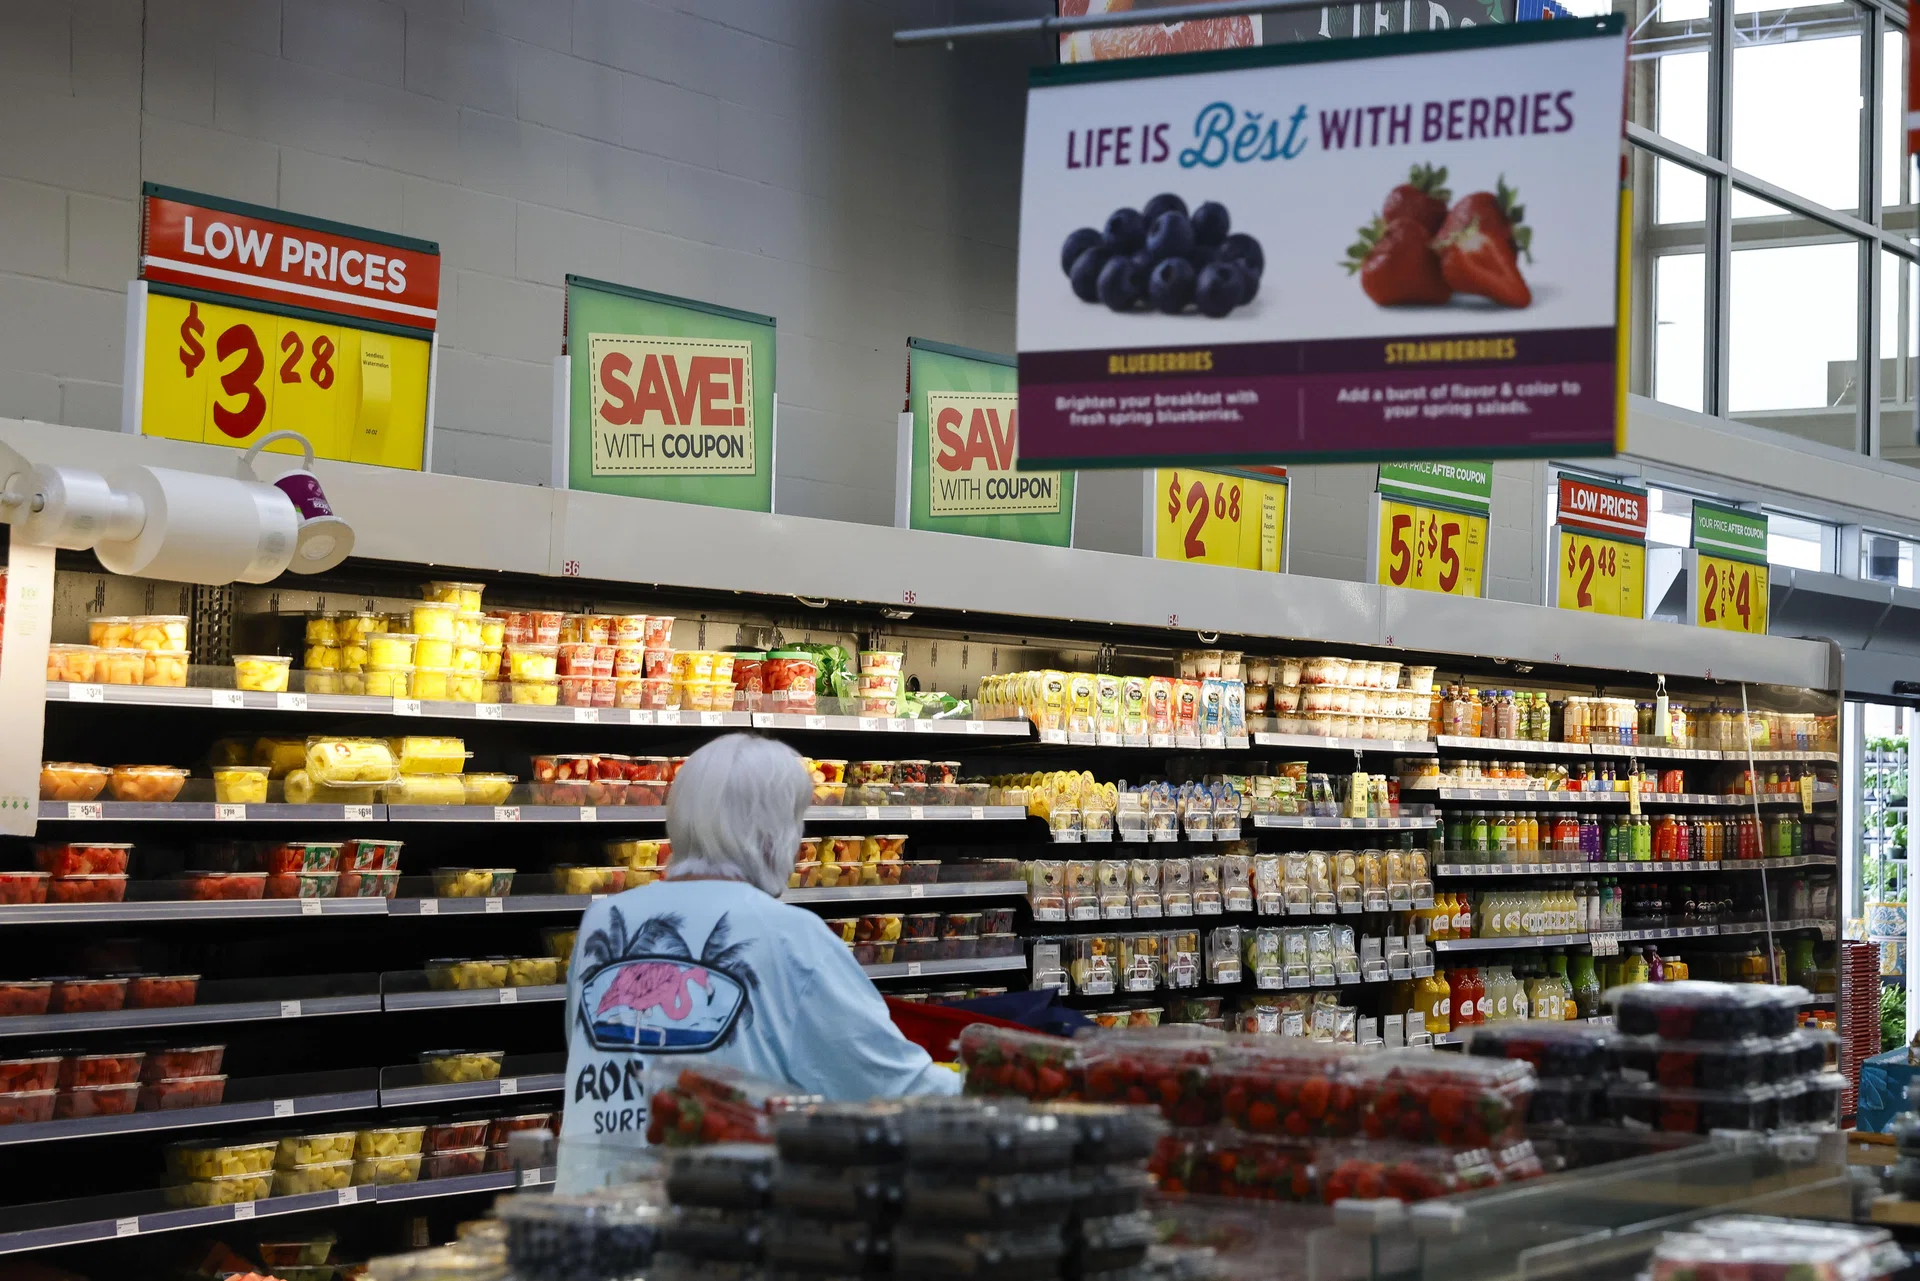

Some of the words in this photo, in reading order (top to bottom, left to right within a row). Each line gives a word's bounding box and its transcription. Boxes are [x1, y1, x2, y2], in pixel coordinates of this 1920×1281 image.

[1067, 126, 1132, 169] LIFE
[1141, 123, 1170, 164] IS
[1320, 103, 1411, 150] WITH
[1421, 91, 1574, 143] BERRIES
[183, 216, 273, 267] LOW
[281, 236, 407, 294] PRICES
[1108, 351, 1213, 374] BLUEBERRIES
[1384, 338, 1517, 364] STRAWBERRIES
[363, 360, 389, 368] Watermelon
[600, 352, 745, 426] SAVE!
[1055, 394, 1116, 411] Brighten
[1119, 396, 1152, 410] your
[1154, 390, 1222, 406] breakfast
[1225, 388, 1259, 404] with
[1337, 386, 1370, 402] Add
[1372, 390, 1383, 401] a
[1385, 384, 1427, 400] burst
[1429, 384, 1448, 400] of
[1450, 382, 1498, 399] flavor
[1500, 381, 1512, 397] &
[1515, 380, 1558, 397] color
[1561, 380, 1581, 396] to
[1069, 411, 1106, 426] fresh
[1109, 410, 1153, 427] spring
[1156, 406, 1243, 424] blueberries.
[1382, 404, 1419, 421] your
[1422, 401, 1473, 419] spring
[1475, 399, 1532, 416] salads.
[604, 433, 654, 458] WITH
[662, 433, 743, 458] COUPON
[936, 407, 1017, 472] SAV
[1409, 462, 1431, 474] PRICE
[1431, 463, 1455, 478] AFTER
[1456, 468, 1486, 484] COUPON
[940, 478, 980, 500] WITH
[986, 477, 1051, 499] COUPON
[1570, 487, 1598, 513] LOW
[1599, 494, 1639, 521] PRICES
[1699, 516, 1714, 529] YOUR
[1714, 519, 1728, 532] PRICE
[1728, 523, 1744, 536] AFTER
[1744, 526, 1764, 540] COUPON
[1390, 514, 1411, 585] 5
[1416, 520, 1425, 578] FOR
[562, 560, 579, 576] B6
[903, 590, 916, 604] B5
[1704, 563, 1718, 623] 2
[594, 1107, 647, 1135] SURF
